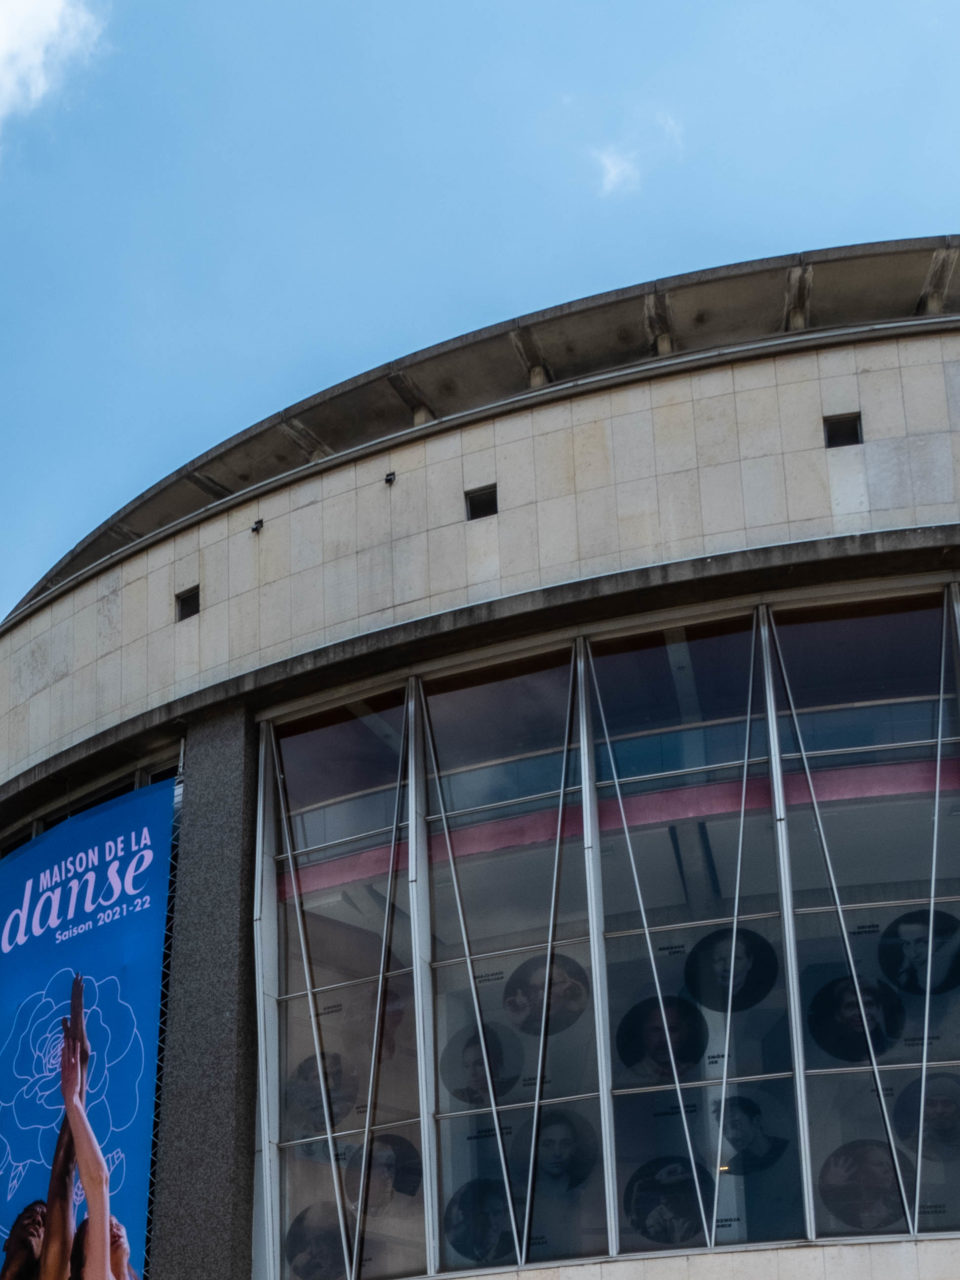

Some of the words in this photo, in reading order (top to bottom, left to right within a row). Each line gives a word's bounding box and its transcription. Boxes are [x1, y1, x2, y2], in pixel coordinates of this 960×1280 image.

[39, 846, 100, 893] MAISON
[105, 836, 125, 862] DE
[131, 826, 152, 852] LA
[1, 849, 154, 954] danse
[55, 920, 93, 944] Saison
[97, 895, 151, 927] 2021-22
